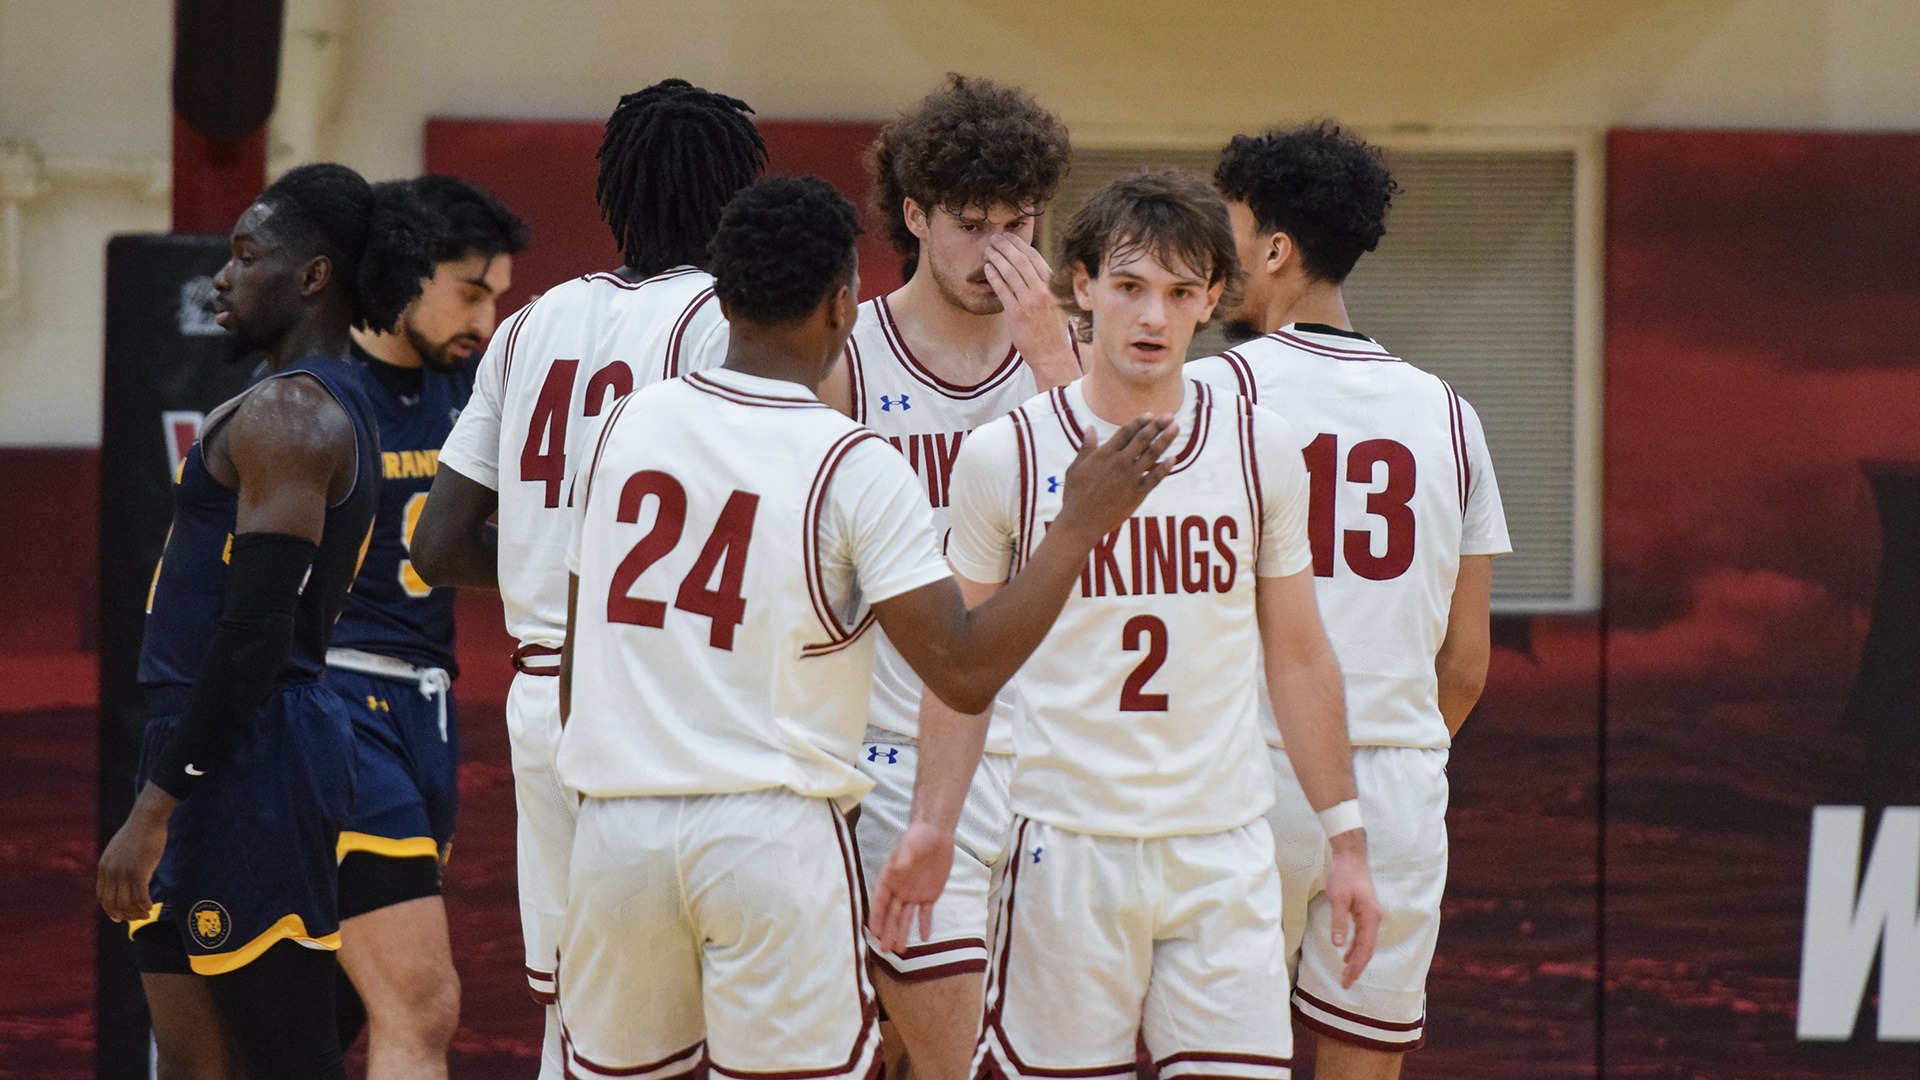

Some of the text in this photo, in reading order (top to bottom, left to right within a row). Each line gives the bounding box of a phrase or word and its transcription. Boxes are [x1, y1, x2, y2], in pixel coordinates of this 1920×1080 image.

[607, 469, 760, 651] 24
[1045, 515, 1238, 598] KINGS
[1302, 433, 1416, 580] 13
[1119, 614, 1168, 712] 2
